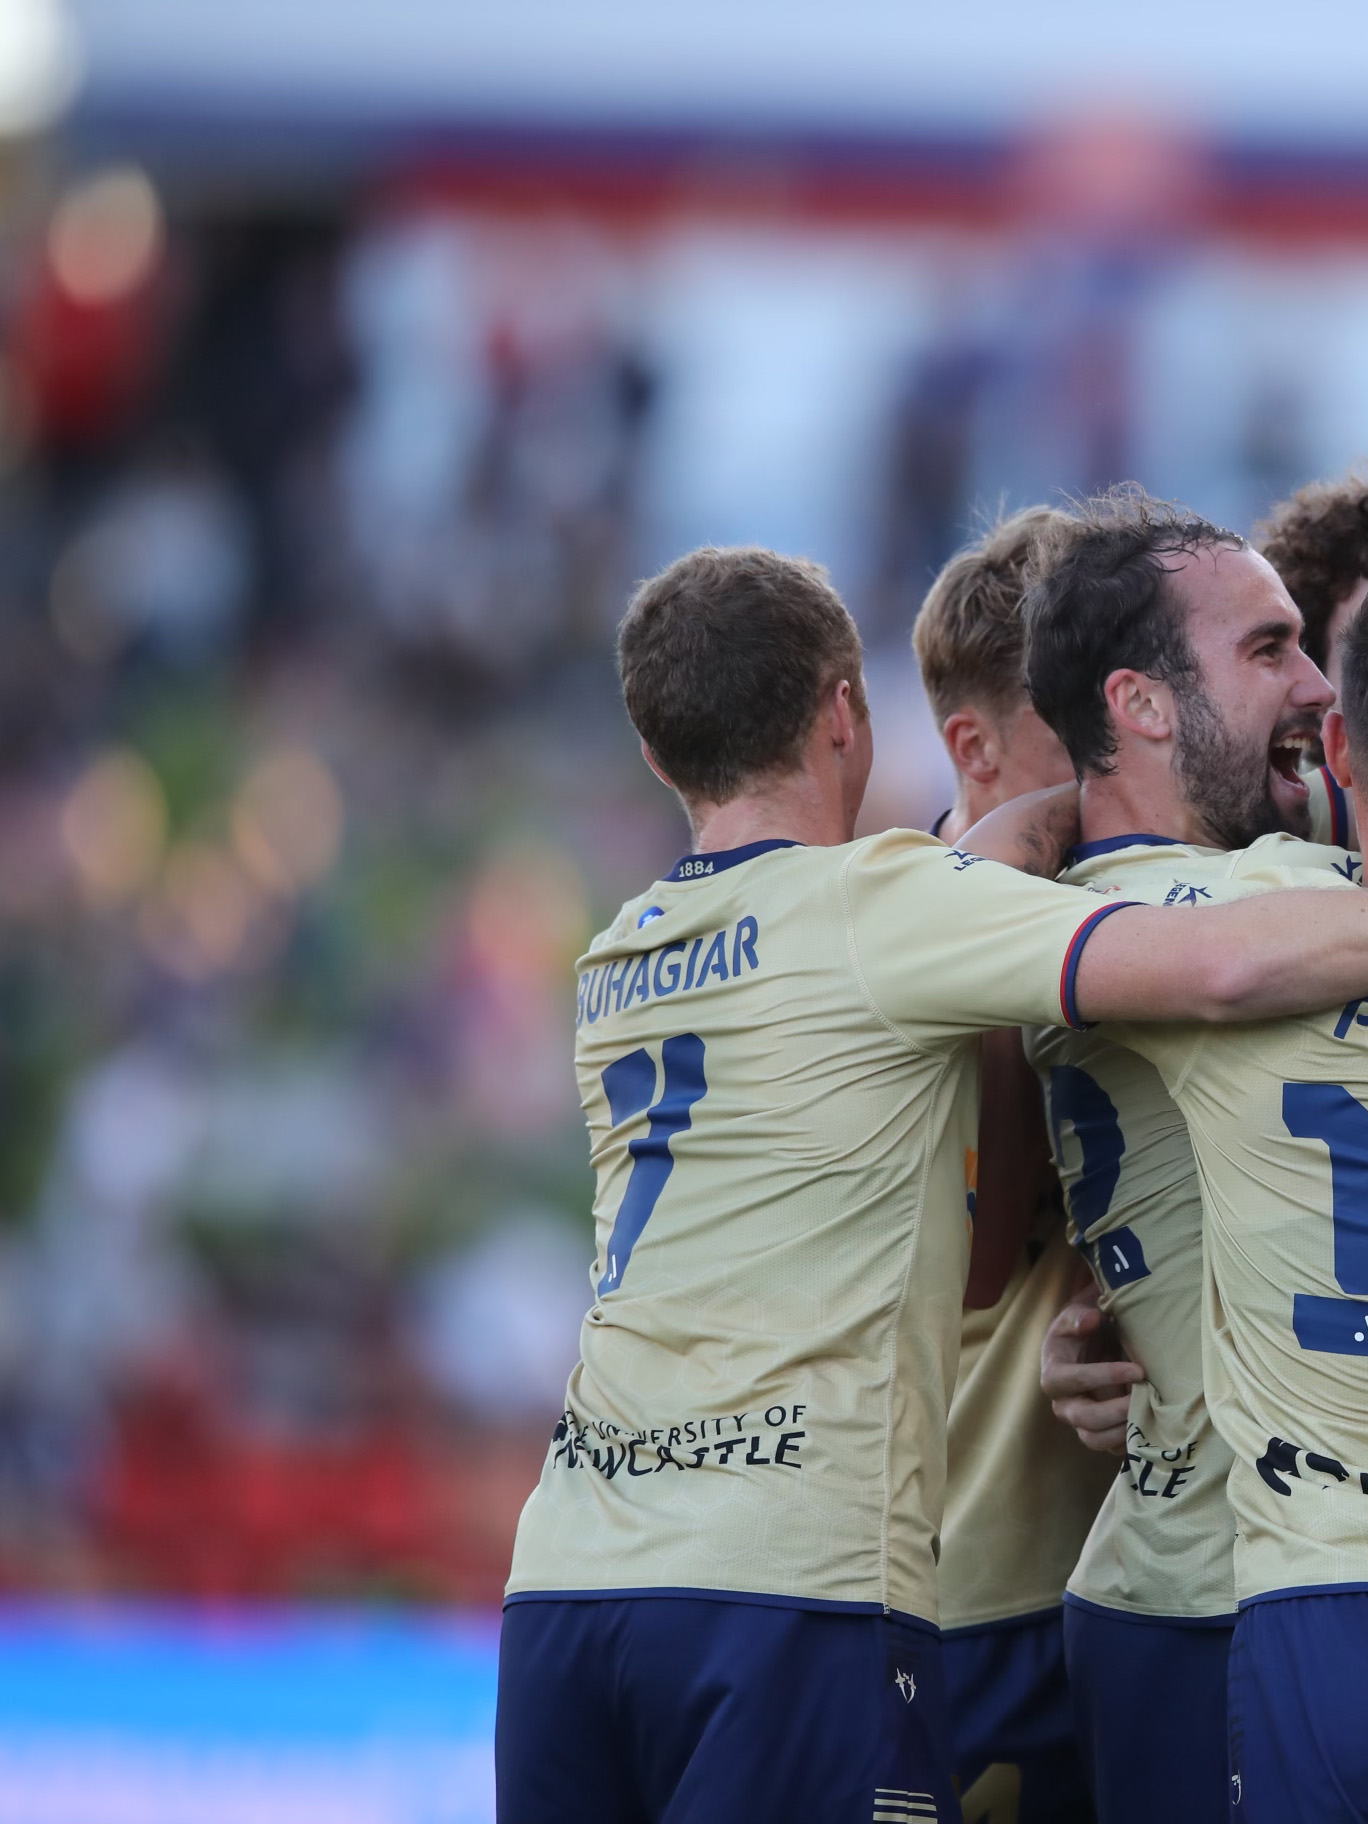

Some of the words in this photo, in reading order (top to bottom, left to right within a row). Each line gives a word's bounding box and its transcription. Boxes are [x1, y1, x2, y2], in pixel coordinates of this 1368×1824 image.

[679, 861, 714, 878] 1884
[577, 915, 760, 1029] BUHAGIAR
[598, 1032, 708, 1298] 7
[765, 1405, 806, 1426] OF
